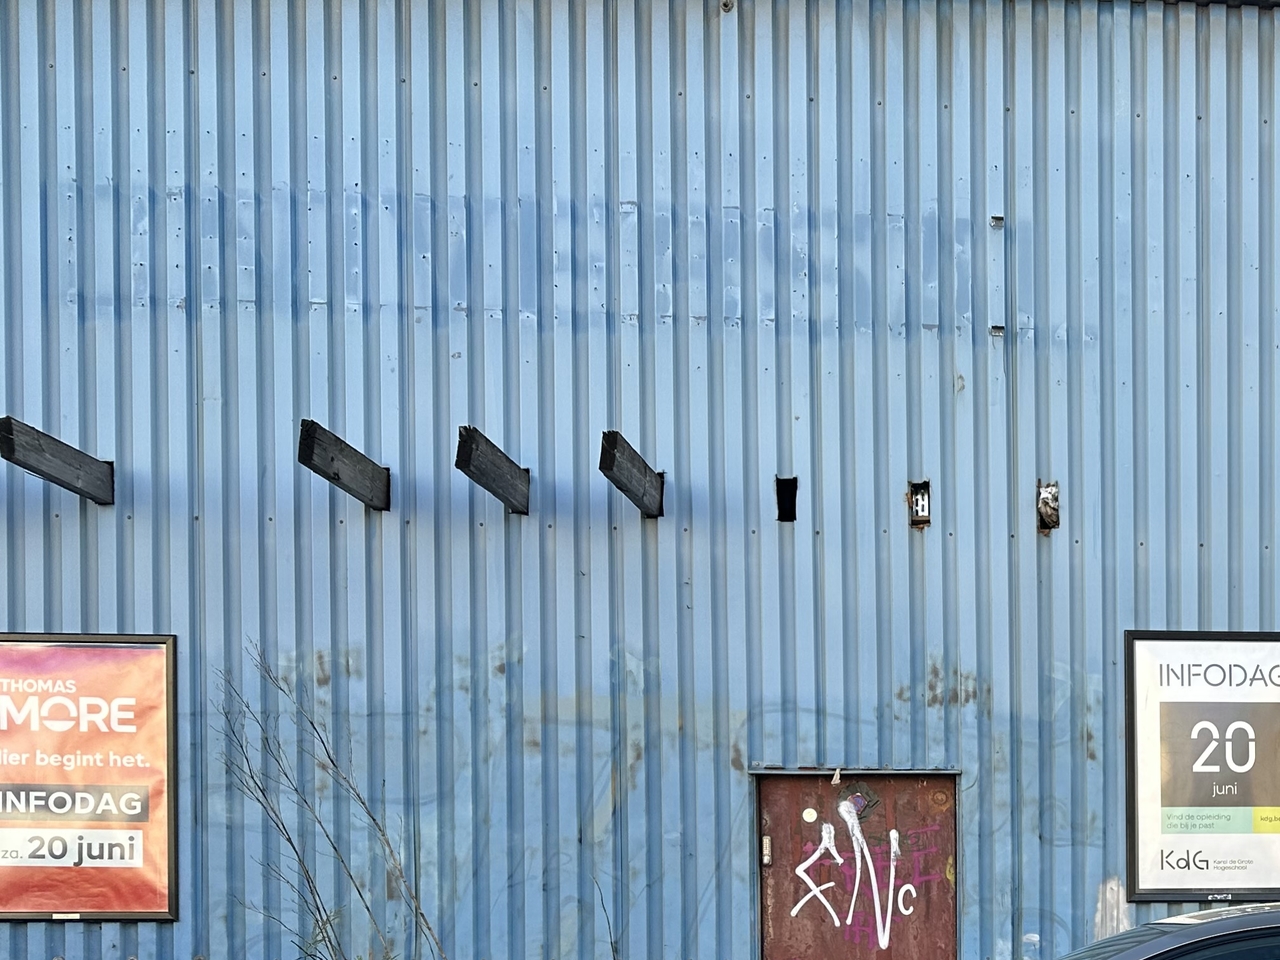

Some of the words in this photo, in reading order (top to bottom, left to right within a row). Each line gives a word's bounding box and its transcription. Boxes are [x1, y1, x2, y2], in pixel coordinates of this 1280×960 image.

[0, 678, 77, 694] THOMAS
[0, 694, 137, 733] MORE
[1190, 720, 1256, 773] 20
[0, 748, 30, 766] ier
[35, 749, 104, 771] begint
[109, 750, 151, 768] het.
[1212, 782, 1238, 798] juni
[1166, 813, 1183, 821] Vind
[1185, 813, 1195, 821] de
[1196, 813, 1231, 822] opleiding
[1180, 822, 1189, 830] bij
[1190, 822, 1197, 830] je
[1199, 822, 1215, 830] past
[1, 849, 23, 860] za.
[27, 835, 69, 860] 20
[73, 835, 136, 867] juni
[1160, 849, 1209, 870] KdG
